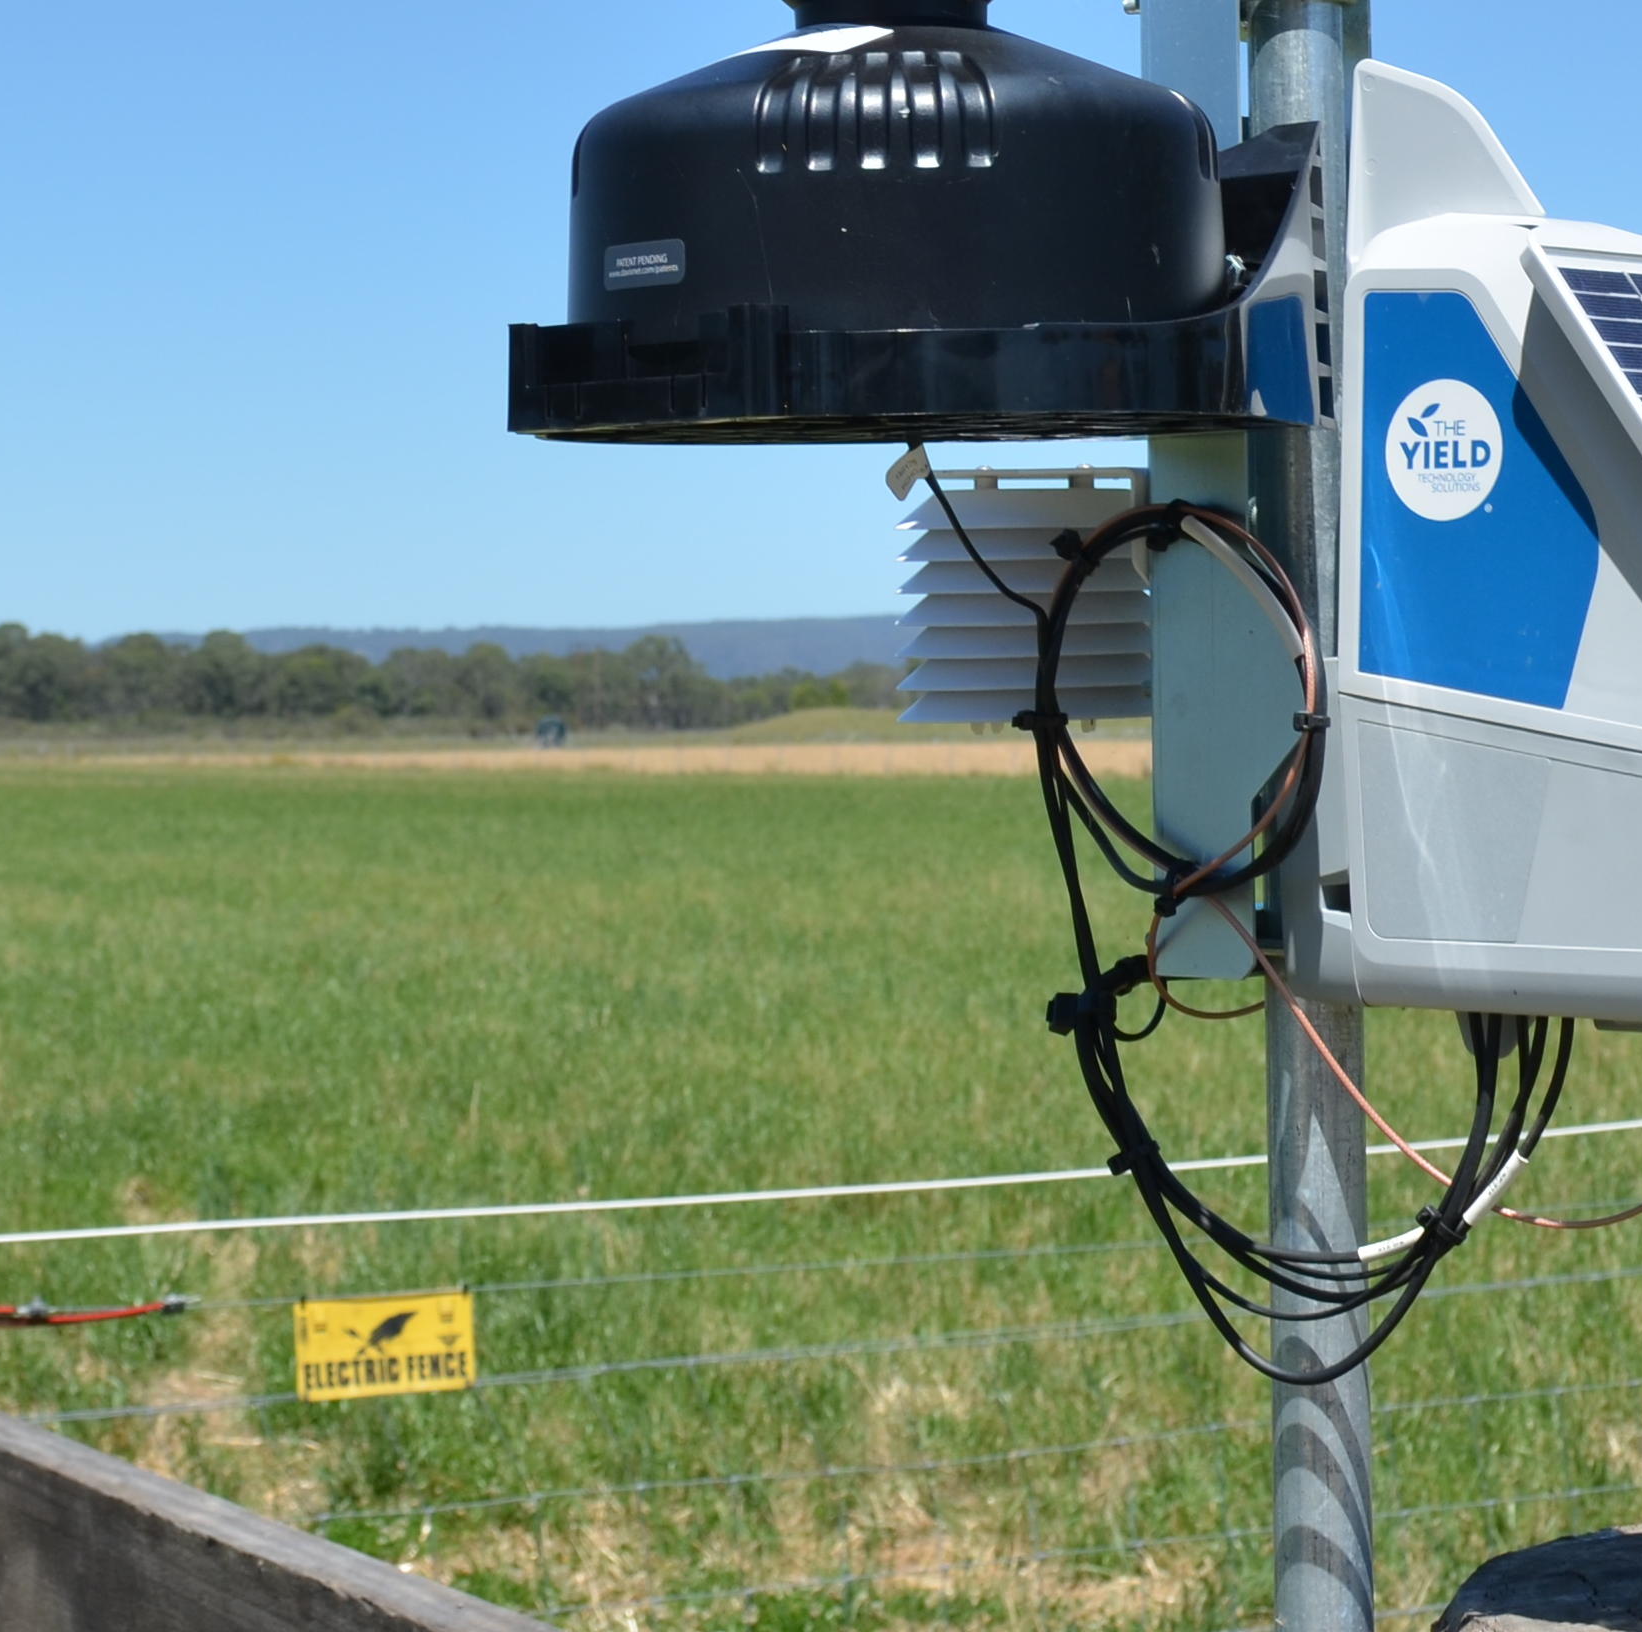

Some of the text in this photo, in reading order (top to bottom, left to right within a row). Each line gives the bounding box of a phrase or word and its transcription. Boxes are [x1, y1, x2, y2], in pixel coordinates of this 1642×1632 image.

[638, 253, 668, 266] PENDING
[1433, 419, 1466, 437] THE
[1399, 440, 1491, 470] YIELD
[1417, 472, 1477, 484] TECHNOLOGY
[1431, 482, 1481, 493] SOLUTIONS
[304, 1351, 467, 1390] ELECTRIC FENCE
